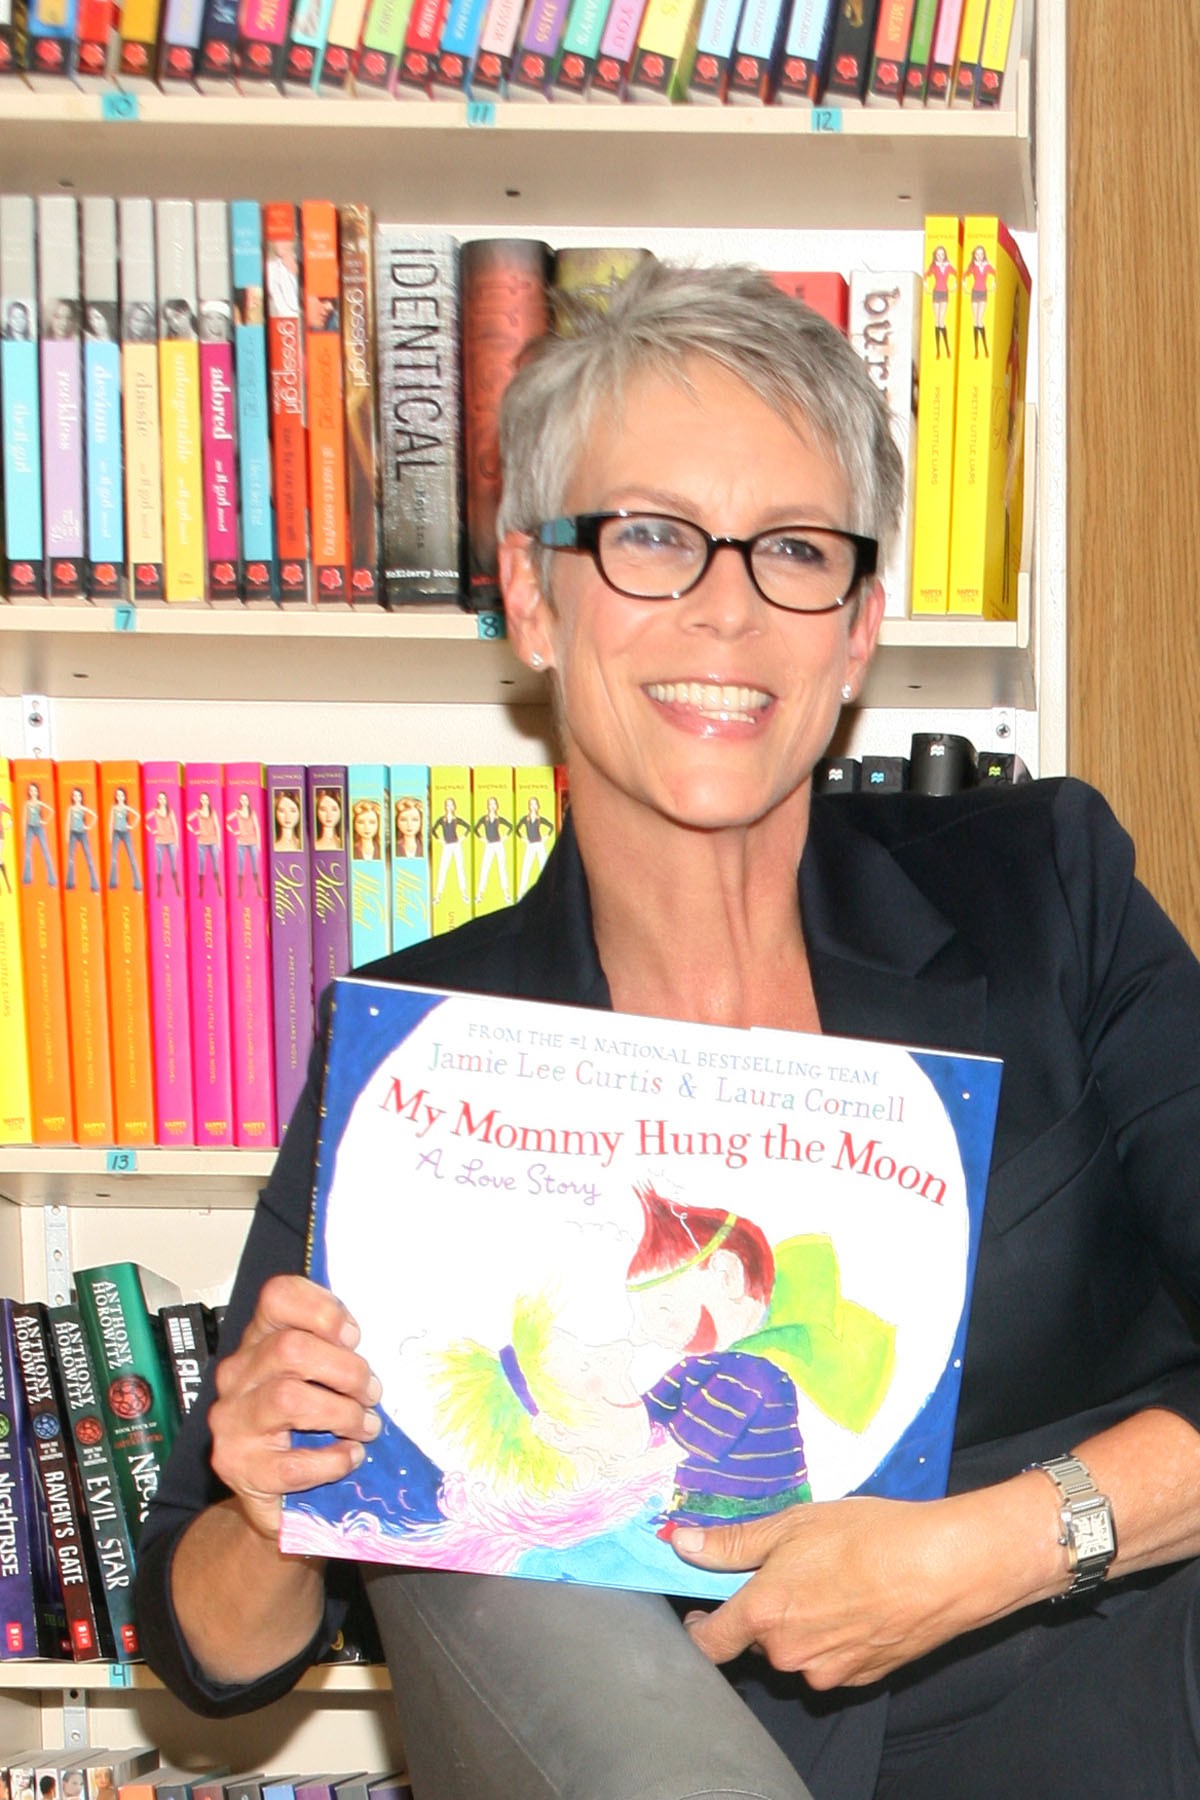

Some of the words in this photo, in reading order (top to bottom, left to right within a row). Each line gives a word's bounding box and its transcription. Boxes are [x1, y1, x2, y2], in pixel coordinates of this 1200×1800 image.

[815, 112, 833, 130] 12
[210, 367, 232, 440] adored
[390, 250, 443, 482] IDENTICAL
[118, 610, 131, 630] 7
[429, 1043, 507, 1076] Jamie
[517, 1053, 566, 1082] Lee
[575, 1061, 661, 1094] Curtis
[679, 1074, 697, 1098] &
[715, 1077, 795, 1111] Laura
[804, 1089, 905, 1122] Cornell
[469, 1022, 522, 1043] FROM
[528, 1031, 563, 1049] THE
[593, 1038, 691, 1065] NATIONAL
[697, 1051, 823, 1081] BESTSELLING
[829, 1066, 880, 1087] TEAM
[112, 1155, 129, 1170] 13
[378, 1077, 448, 1137] My
[451, 1100, 624, 1167] Mommy
[635, 1120, 752, 1168] Hung
[761, 1123, 824, 1163] the
[831, 1131, 949, 1206] Moon
[416, 1149, 445, 1179] A
[456, 1158, 516, 1191] Love
[527, 1164, 602, 1206] Story
[13, 1316, 36, 1405] HOROWITZ
[25, 1315, 53, 1401] ANTHONY
[91, 1281, 120, 1371] HOROWITZ
[101, 1280, 135, 1366] ANTHONY
[54, 1322, 78, 1411] HOROWITZ
[66, 1321, 96, 1407] ANTHONY
[0, 1472, 19, 1577] NIGHTRISE
[44, 1471, 75, 1538] RAVEN'S
[86, 1474, 118, 1531] EVIL
[58, 1545, 84, 1587] GATE
[97, 1538, 129, 1590] STAR
